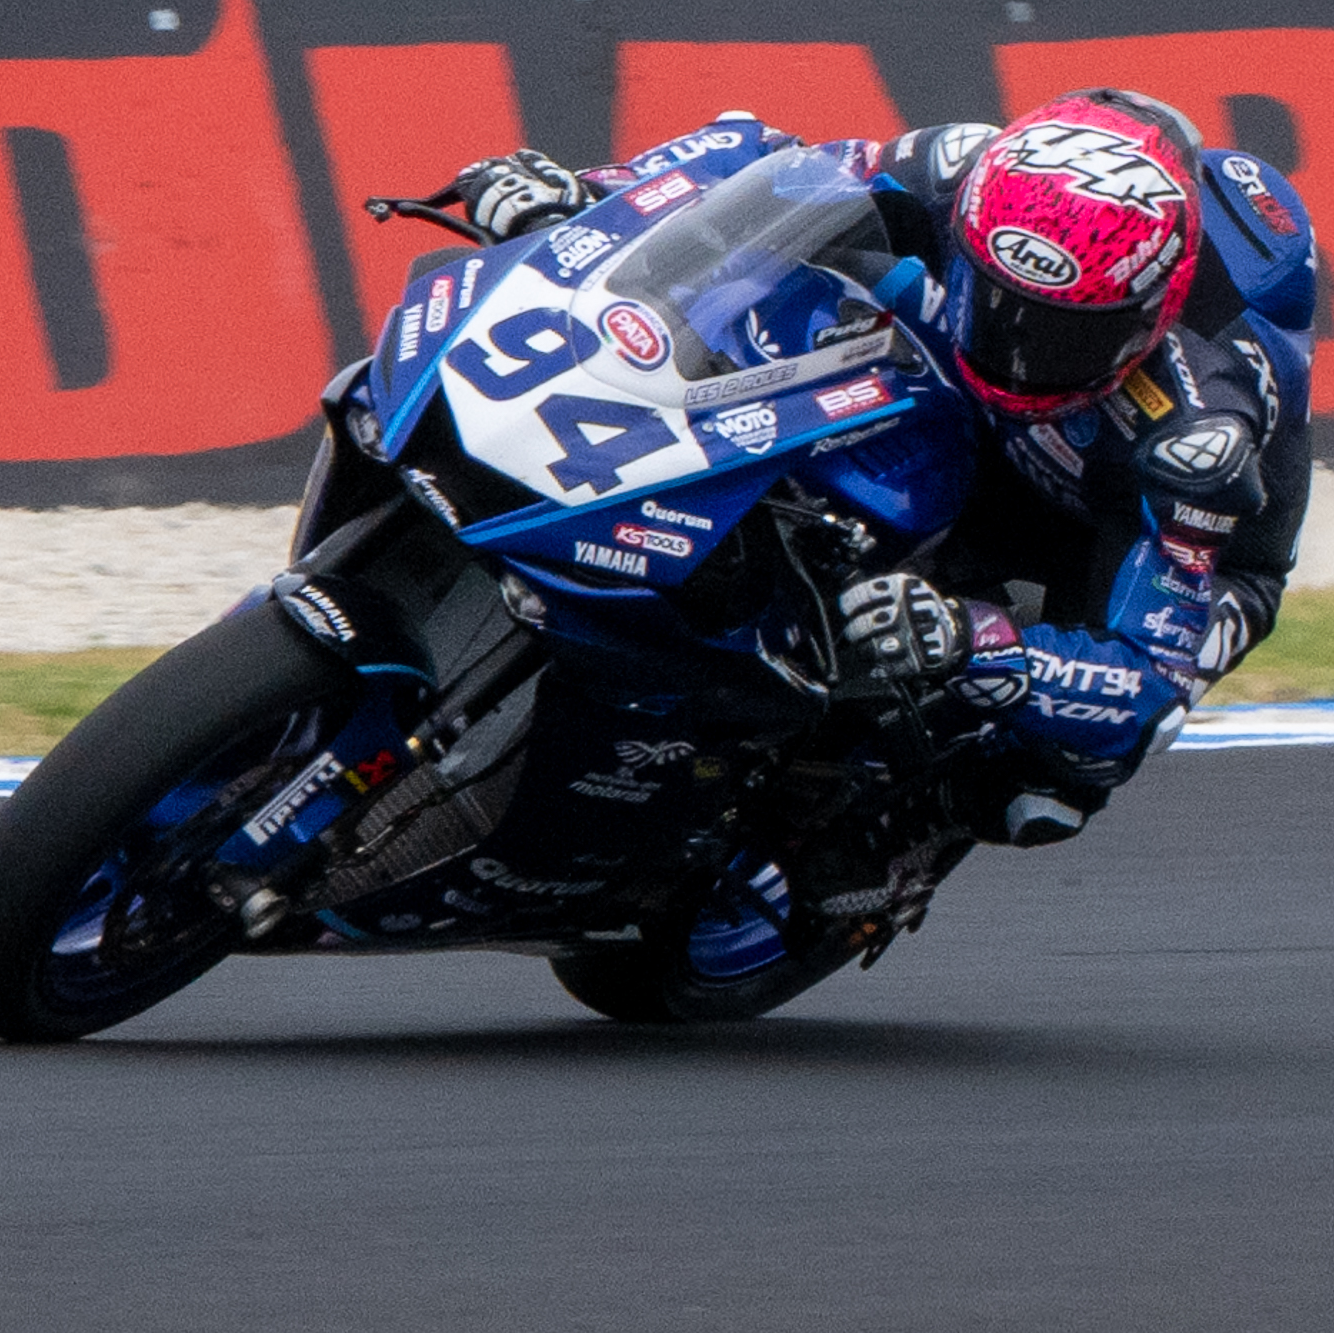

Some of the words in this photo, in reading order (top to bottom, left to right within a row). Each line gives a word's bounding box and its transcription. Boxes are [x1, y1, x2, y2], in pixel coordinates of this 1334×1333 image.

[994, 237, 1067, 278] Arai
[397, 302, 424, 363] YAMAHA
[609, 311, 652, 358] PATA
[445, 306, 681, 497] 94
[685, 383, 720, 407] LES
[720, 377, 741, 399] 2
[815, 378, 881, 414] BS
[714, 407, 778, 440] MOTO
[640, 499, 713, 531] Quorum
[573, 540, 649, 578] YAMAHA
[298, 584, 357, 643] YAMAHA
